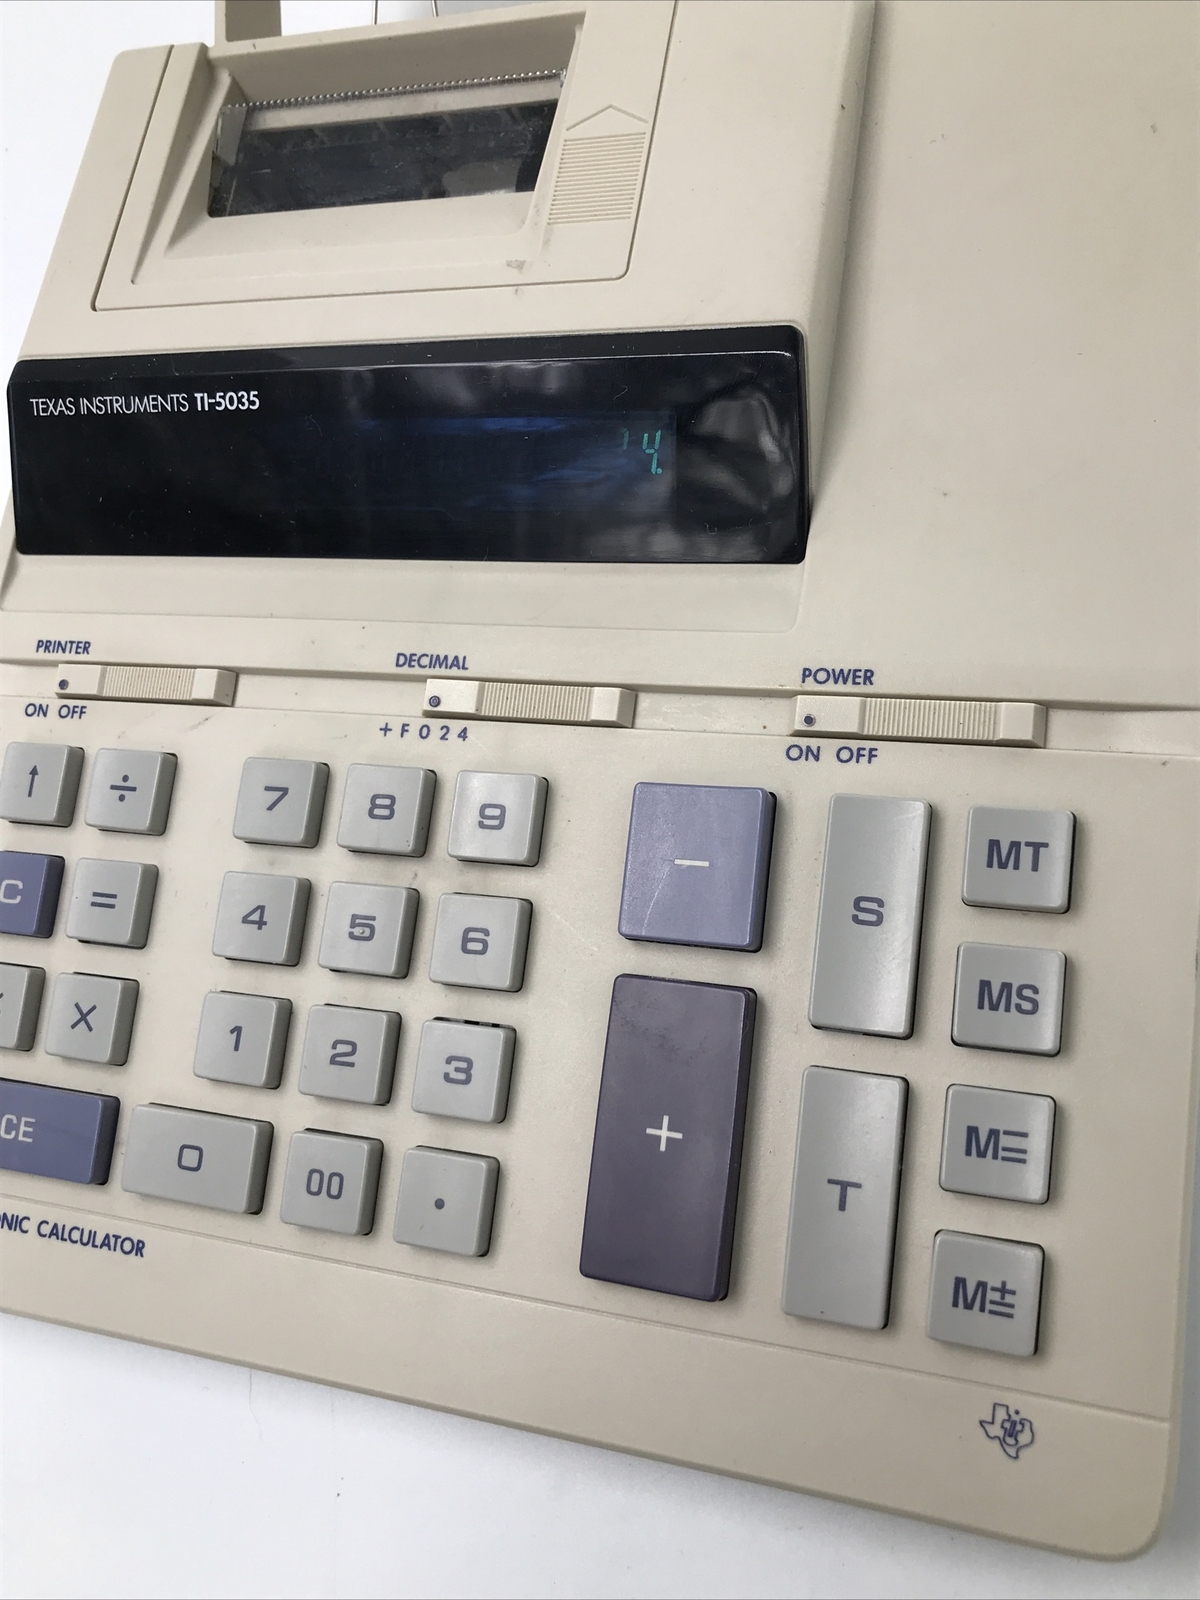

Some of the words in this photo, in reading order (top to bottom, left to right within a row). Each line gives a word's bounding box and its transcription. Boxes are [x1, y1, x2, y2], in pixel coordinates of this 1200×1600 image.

[30, 398, 75, 415] TEXAS
[80, 394, 188, 414] INSTRUMENTS
[194, 391, 259, 411] TI-5035
[36, 640, 91, 654] PRINTER
[396, 653, 468, 670] DECIMAL
[802, 668, 874, 685] POWER
[25, 703, 49, 717] ON
[58, 705, 87, 719] OFF
[786, 744, 820, 762] ON
[836, 746, 878, 764] OFF
[264, 786, 289, 811] 7
[368, 794, 396, 820] 8
[478, 803, 506, 830] 9
[986, 839, 1049, 872] MT
[0, 880, 23, 903] C
[242, 905, 267, 930] 4
[852, 896, 884, 926] S
[348, 914, 376, 941] 5
[461, 927, 490, 955] 6
[977, 980, 1039, 1015] MS
[230, 1026, 242, 1051] 1
[330, 1040, 357, 1067] 2
[443, 1056, 473, 1085] 3
[0, 1115, 35, 1142] CE
[306, 1169, 344, 1200] 00
[827, 1179, 862, 1212] T
[0, 1212, 30, 1233] NIC
[37, 1220, 145, 1257] CALCULATOR
